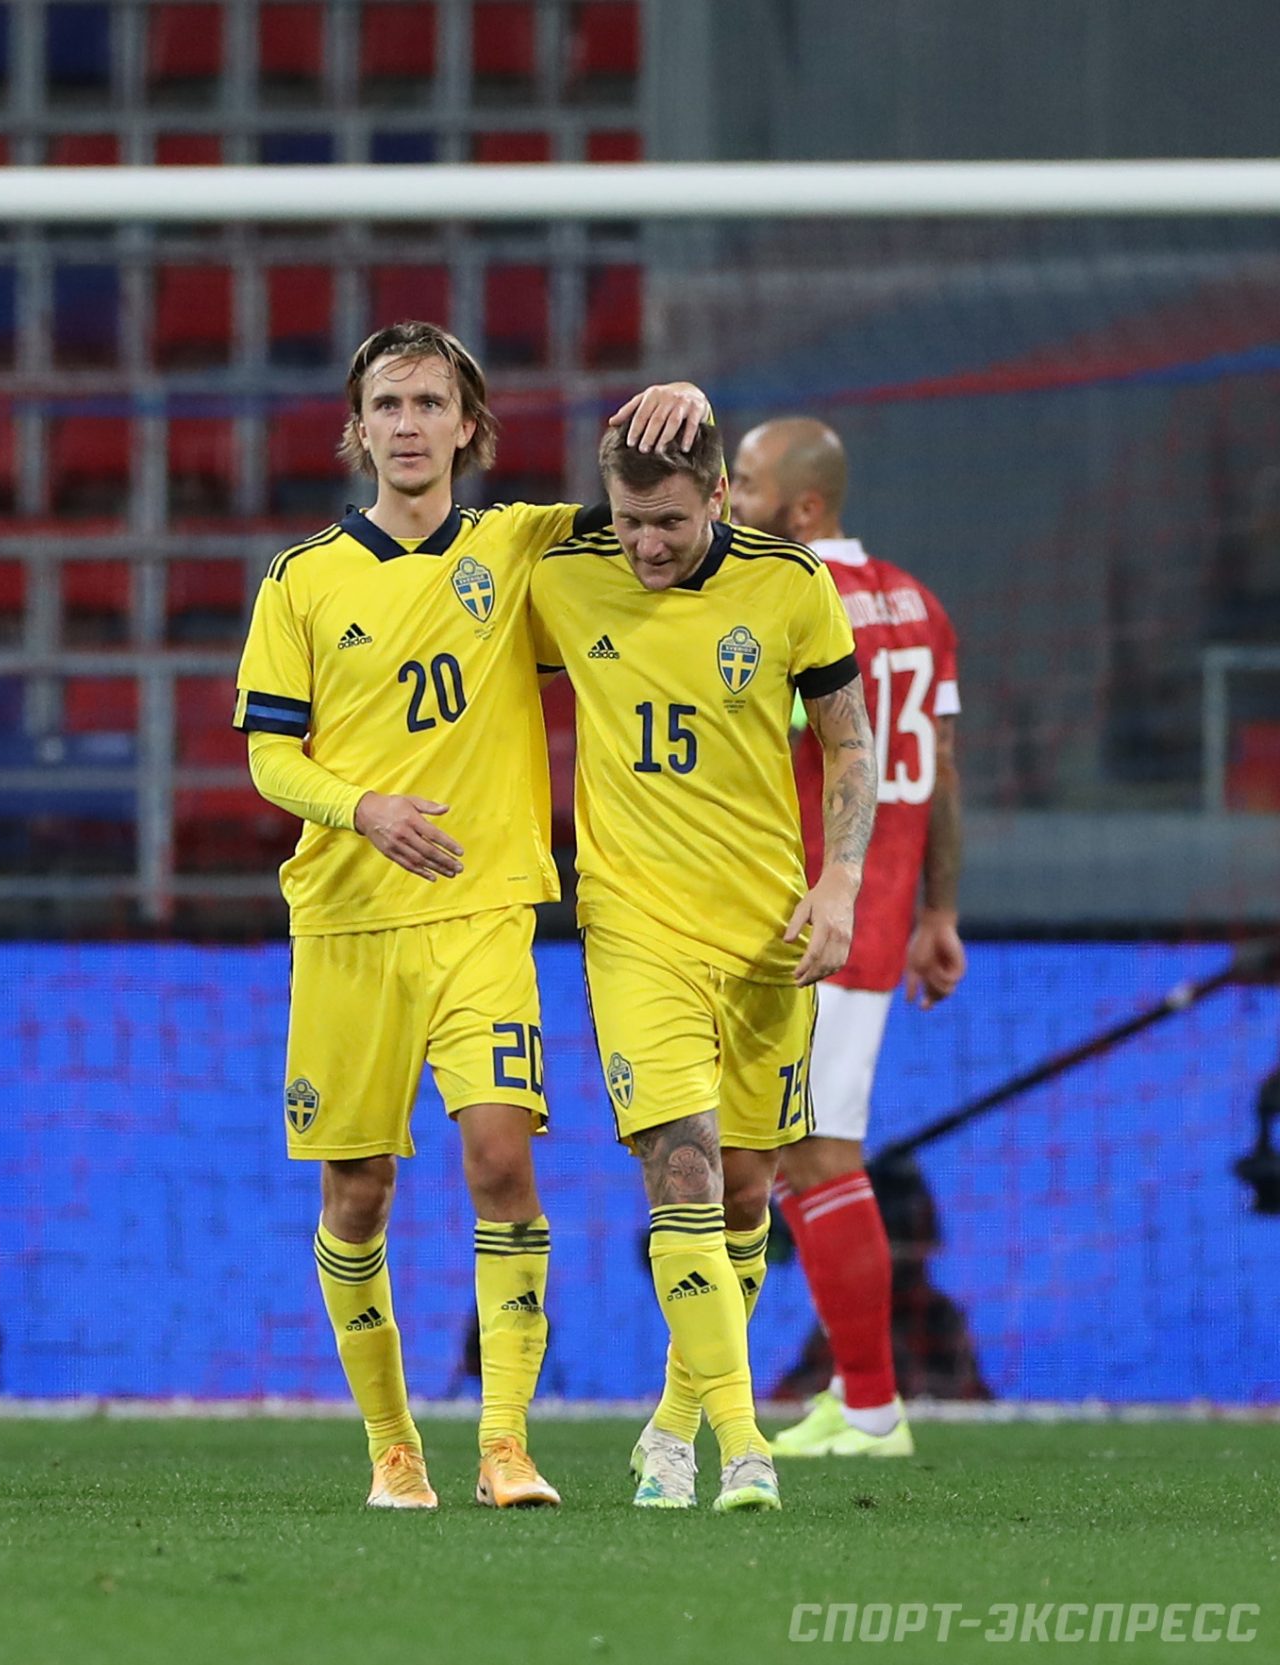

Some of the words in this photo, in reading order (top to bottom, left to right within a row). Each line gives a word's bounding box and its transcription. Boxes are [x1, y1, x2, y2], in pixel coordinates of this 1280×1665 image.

[337, 635, 372, 650] adidas
[588, 650, 620, 660] adidas
[397, 652, 468, 733] 20
[634, 701, 697, 774] 15
[871, 646, 936, 804] 13
[492, 1022, 543, 1095] 20
[666, 1284, 718, 1302] adidas
[345, 1316, 388, 1332] adidas
